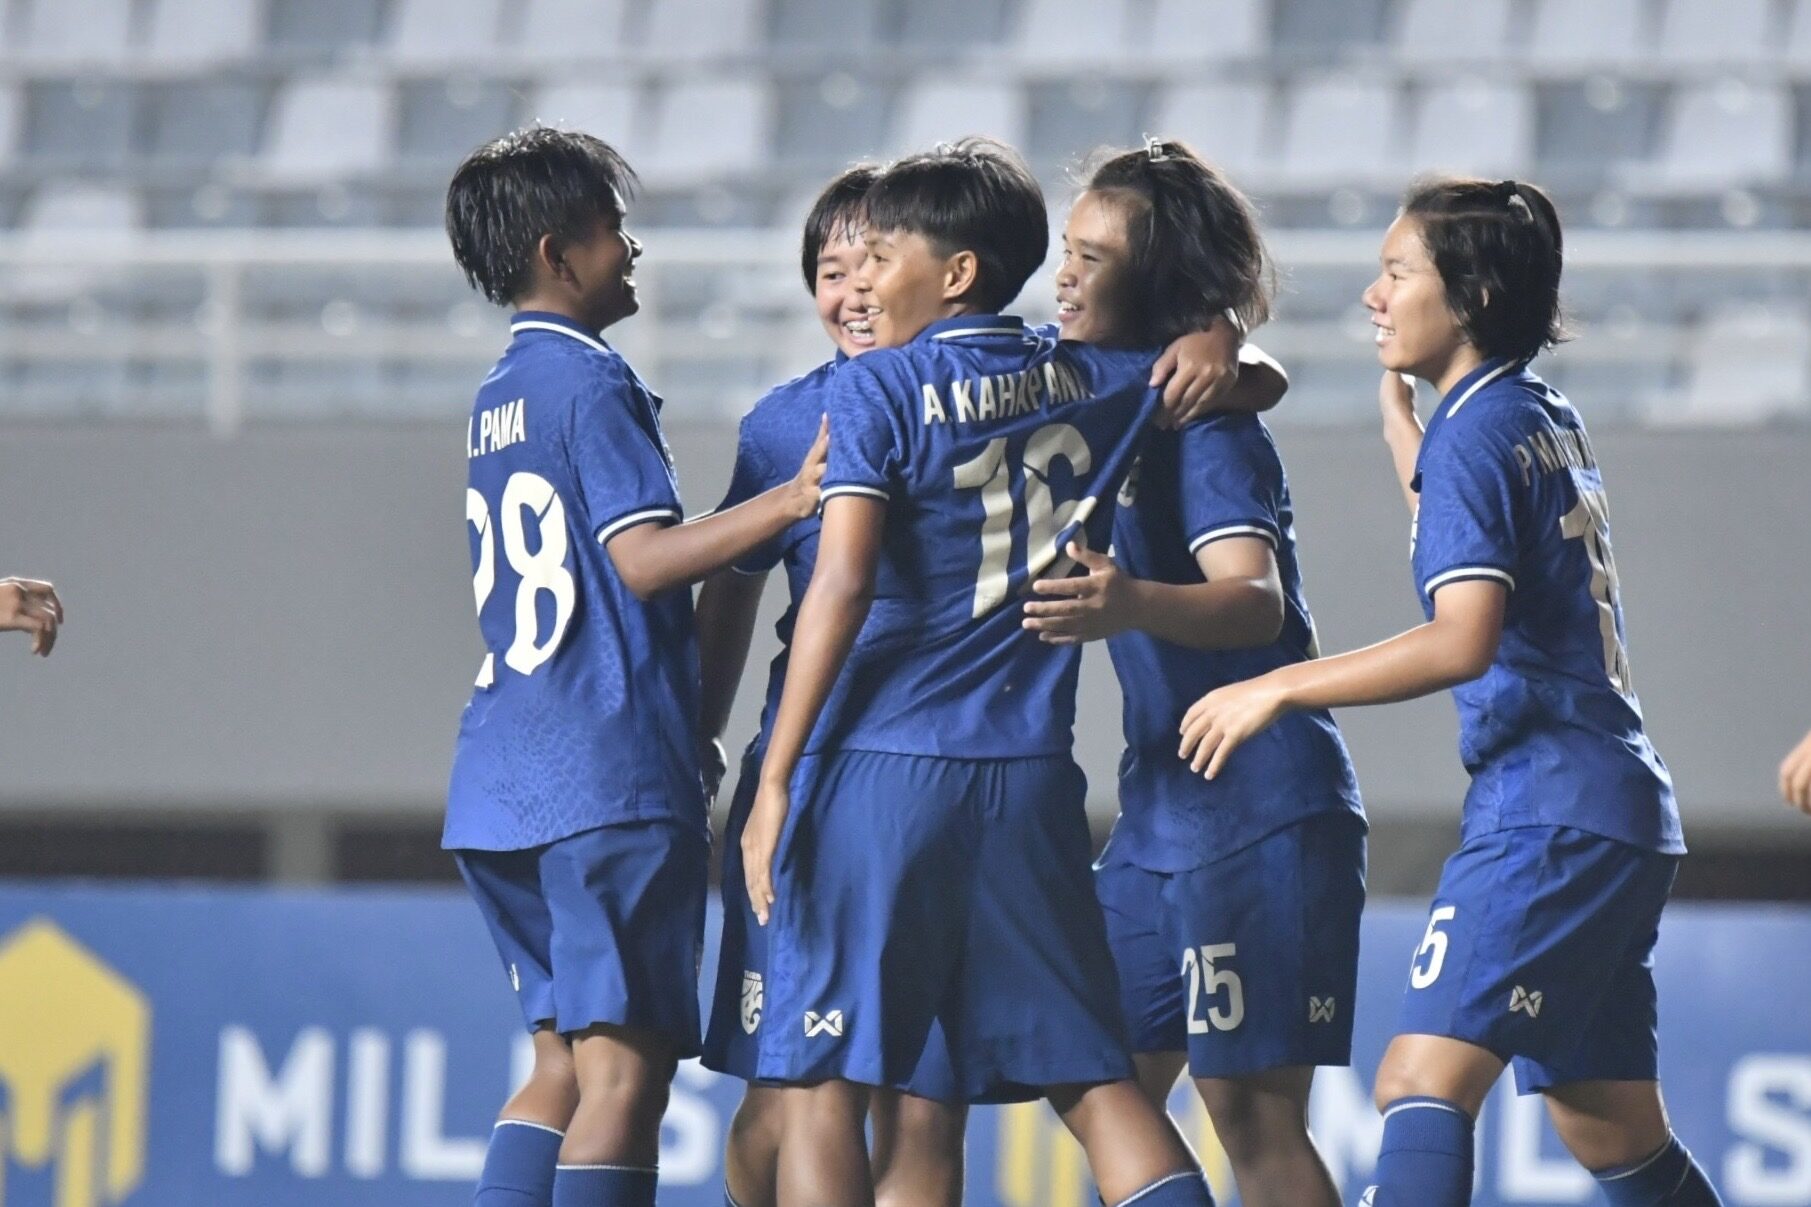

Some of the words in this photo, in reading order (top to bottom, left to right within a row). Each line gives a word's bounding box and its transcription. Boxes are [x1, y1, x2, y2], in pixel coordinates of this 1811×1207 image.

[953, 424, 1091, 618] 16
[1180, 943, 1245, 1034] 25
[1404, 905, 1456, 994] 5
